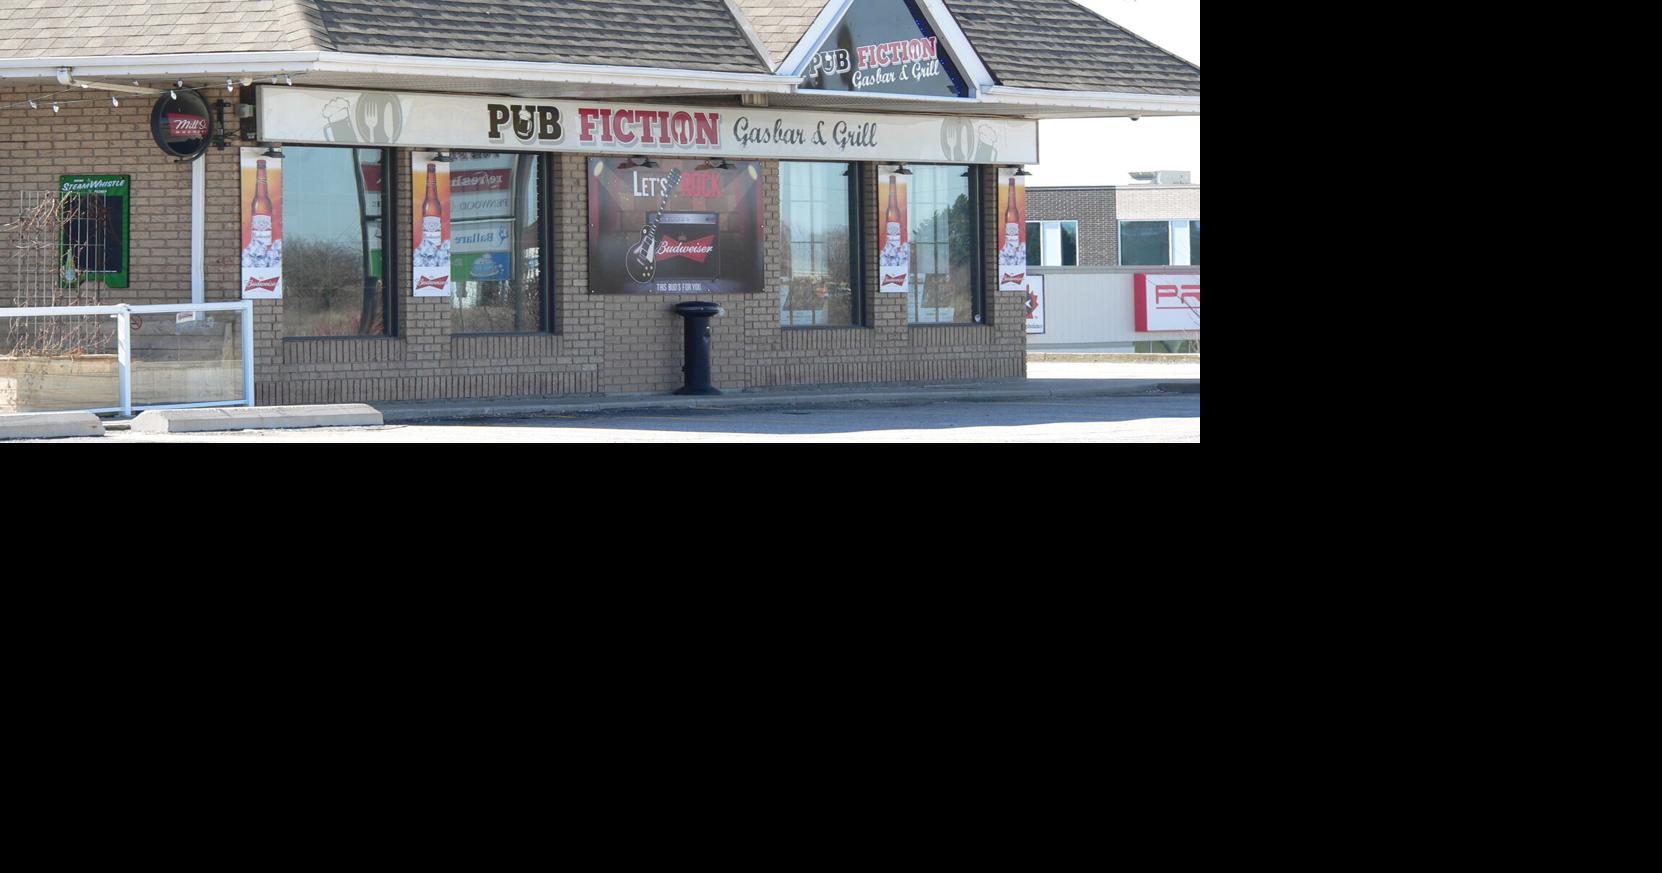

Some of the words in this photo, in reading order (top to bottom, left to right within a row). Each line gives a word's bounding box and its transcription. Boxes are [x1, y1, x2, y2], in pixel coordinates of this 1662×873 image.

[808, 49, 850, 78] PUB
[856, 36, 937, 70] FICTION
[852, 67, 897, 90] Gasbar
[900, 64, 909, 81] &
[911, 59, 940, 82] Grill
[173, 119, 199, 130] Mill
[487, 103, 563, 142] PUB
[577, 107, 721, 147] FICTION
[733, 116, 806, 148] Gasbar
[812, 120, 827, 146] &
[832, 120, 878, 150] Grill
[655, 240, 713, 255] Budweiser
[656, 283, 667, 292] THIS
